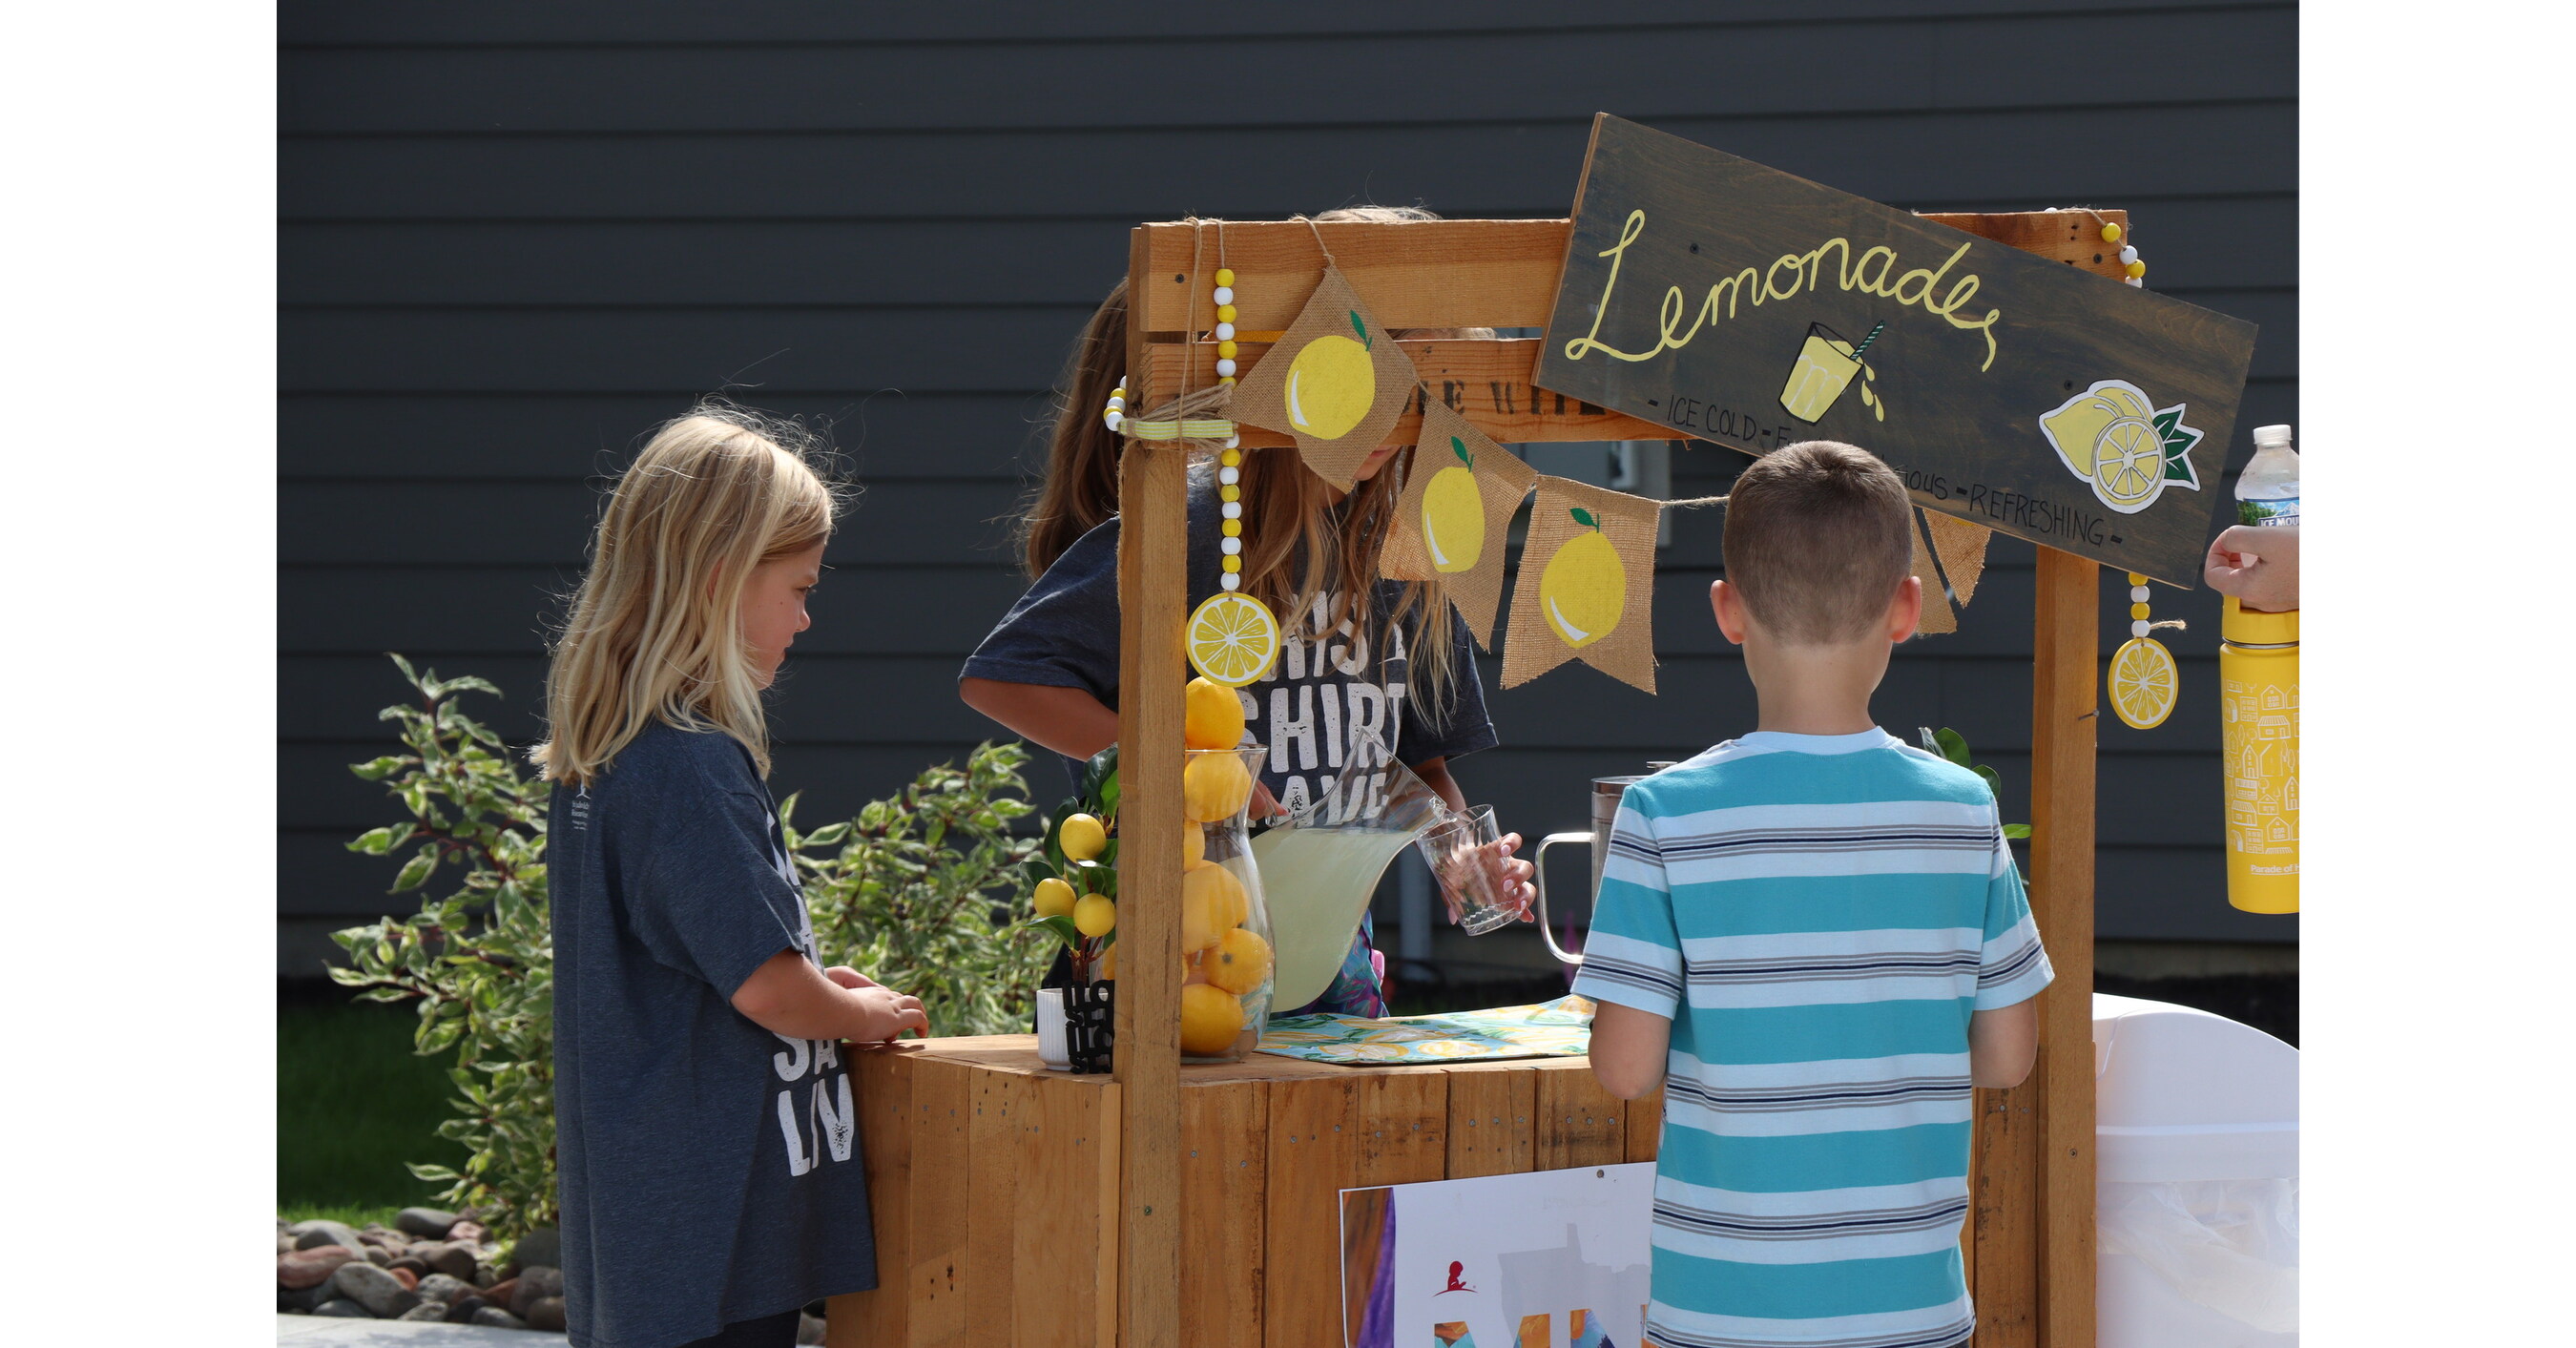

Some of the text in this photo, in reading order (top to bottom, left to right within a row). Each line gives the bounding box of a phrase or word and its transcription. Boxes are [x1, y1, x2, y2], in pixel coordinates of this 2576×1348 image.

[1667, 395, 1701, 428] ICE
[1706, 404, 1757, 443] COLD
[2260, 518, 2275, 527] ICE
[2250, 864, 2282, 873] Parade
[2283, 863, 2294, 873] of
